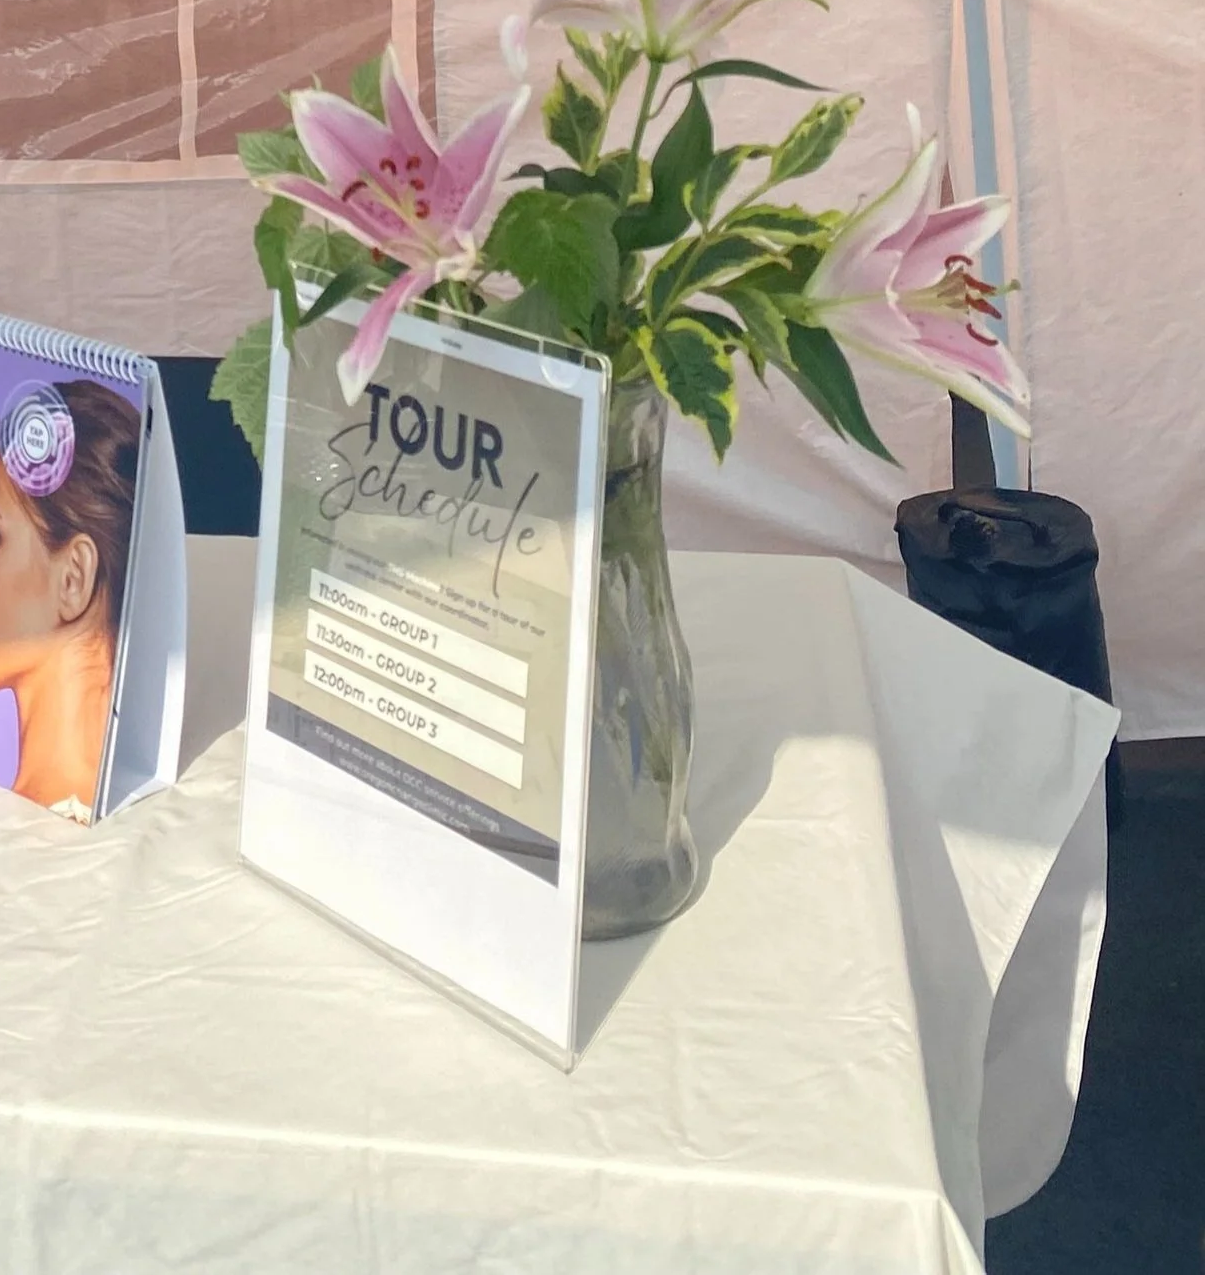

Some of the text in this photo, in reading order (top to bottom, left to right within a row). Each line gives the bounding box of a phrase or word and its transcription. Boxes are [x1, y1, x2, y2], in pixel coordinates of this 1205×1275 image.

[364, 382, 504, 490] TOUR
[319, 422, 543, 599] Schedule
[319, 582, 369, 619] 11:00am
[379, 611, 429, 644] GROUP
[431, 632, 439, 650] 1
[316, 622, 365, 660] 11:30am
[376, 653, 426, 686] GROUP
[427, 677, 437, 695] 2
[313, 664, 366, 704] 12:00pm
[377, 696, 427, 730] GROUP
[428, 722, 439, 739] 3
